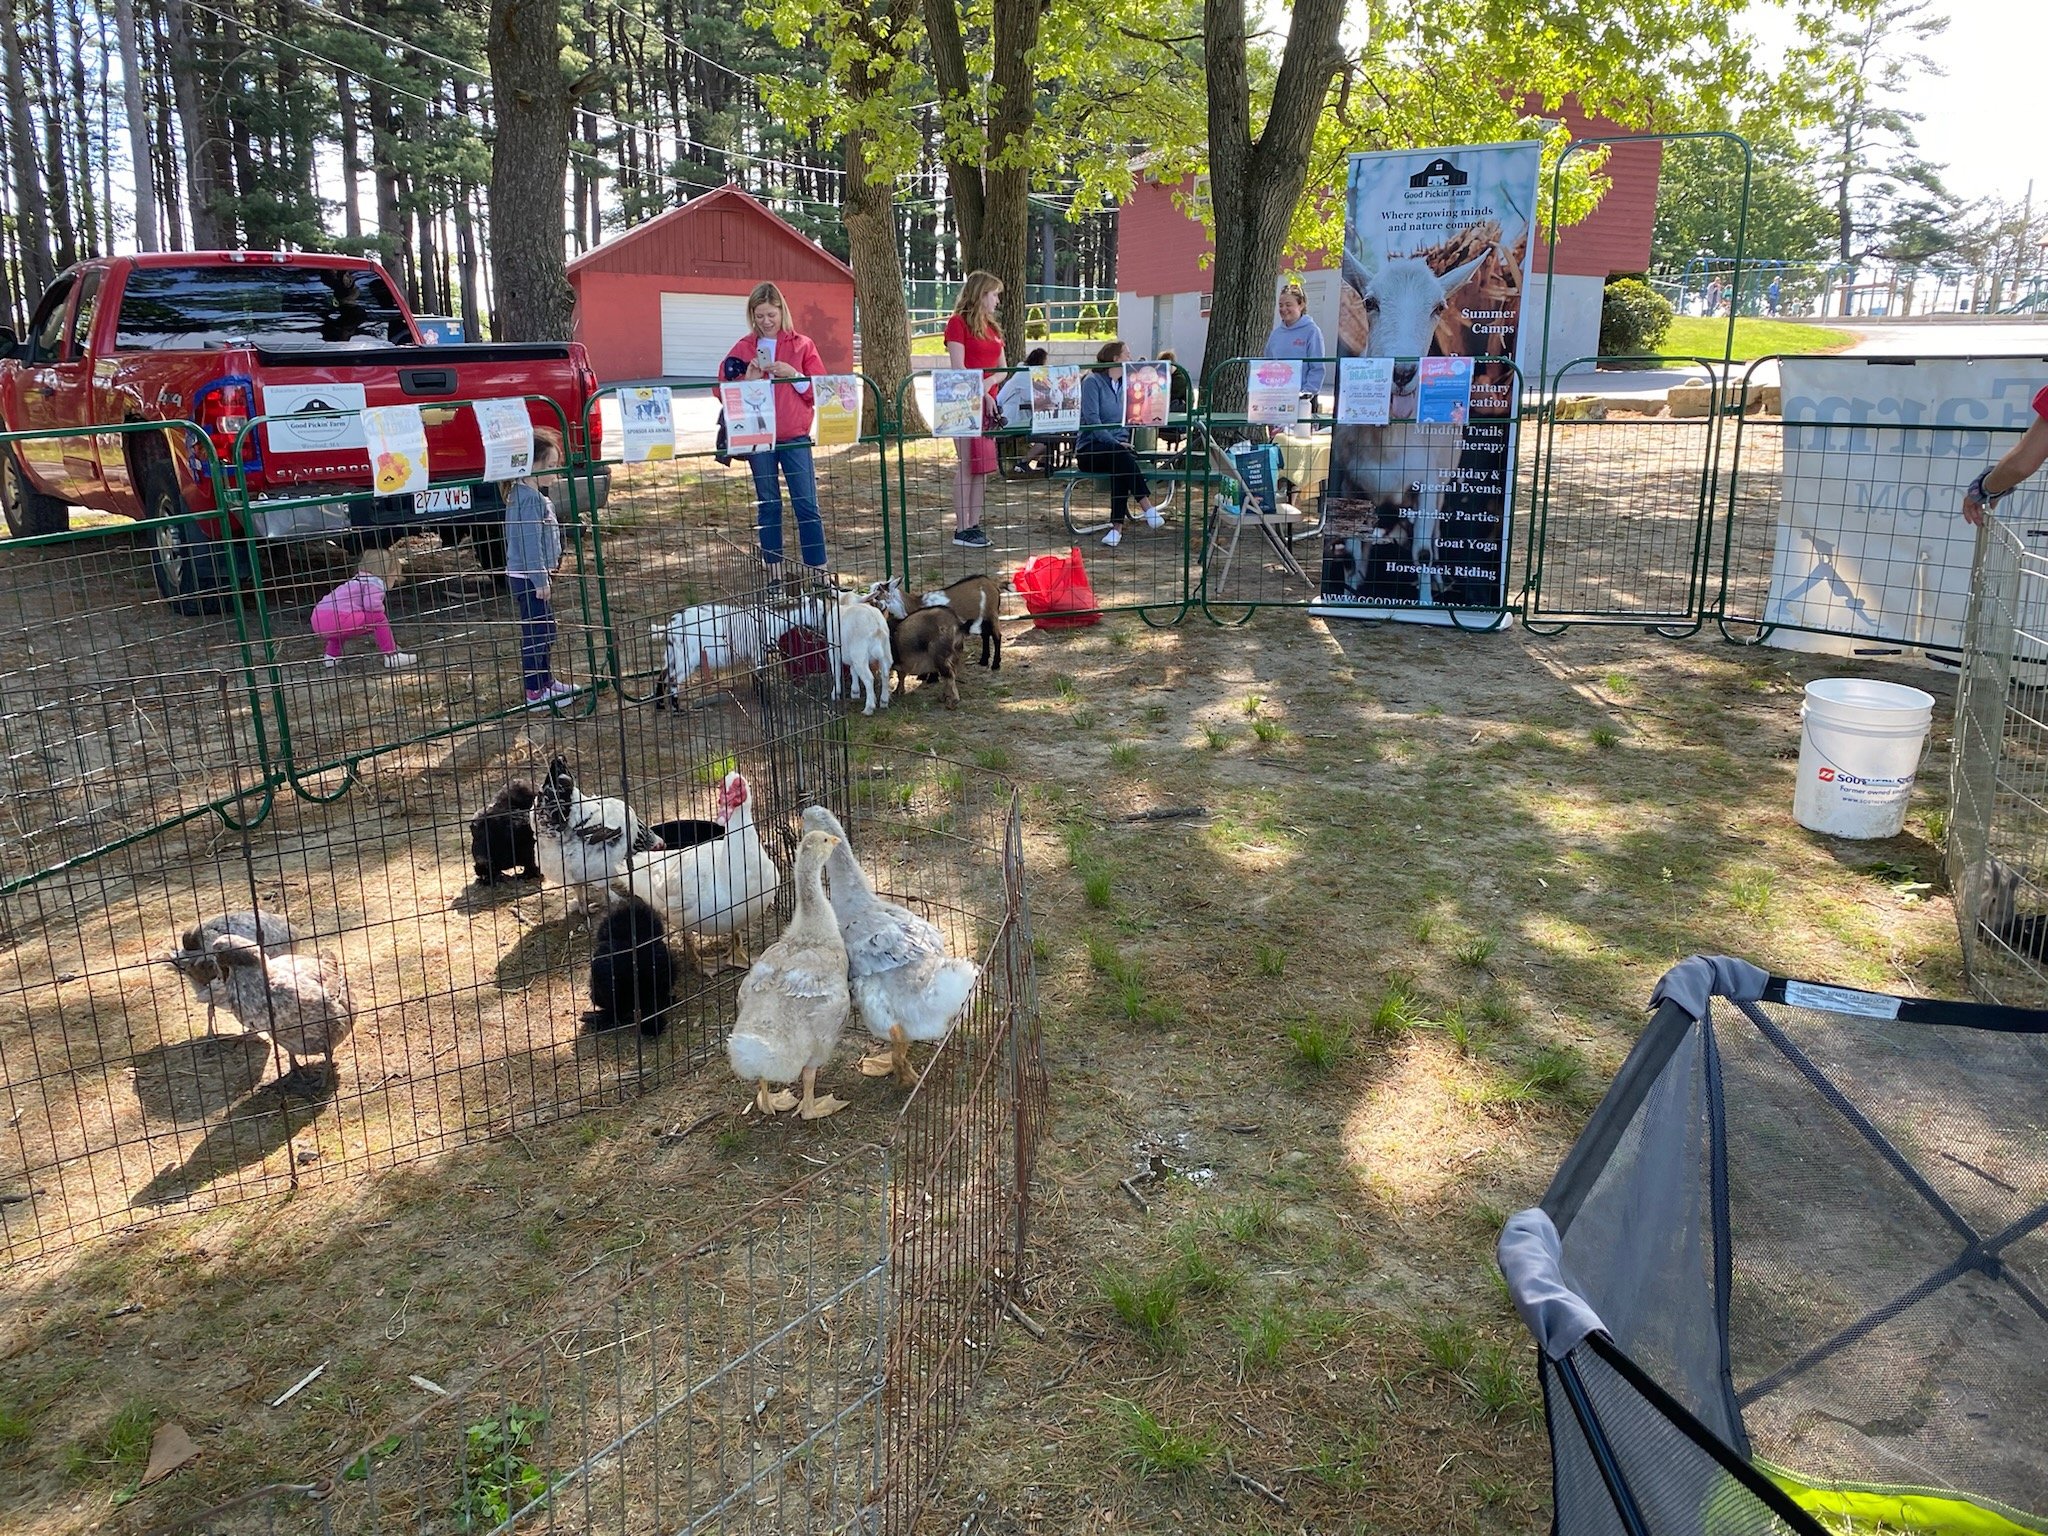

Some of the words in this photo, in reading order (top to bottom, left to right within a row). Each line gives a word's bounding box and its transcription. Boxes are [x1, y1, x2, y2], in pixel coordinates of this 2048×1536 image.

[1403, 190, 1423, 200] Good
[1424, 189, 1450, 199] Pickin'
[1451, 188, 1471, 198] Farm
[1381, 210, 1415, 221] Where
[1416, 208, 1458, 220] growing
[1460, 206, 1494, 217] minds
[1388, 222, 1408, 232] and
[1409, 221, 1443, 231] nature
[1445, 219, 1487, 230] connect
[1461, 308, 1516, 320] Summer
[1471, 323, 1515, 336] Camps
[1470, 383, 1510, 395] entary
[1469, 397, 1509, 409] cation
[290, 421, 308, 430] Good
[329, 420, 346, 428] Farm
[1414, 425, 1463, 435] Mindful
[1466, 426, 1504, 437] Trails
[1453, 439, 1506, 452] Therapy
[276, 463, 370, 478] SIVERADO
[1438, 468, 1489, 481] Holiday
[1489, 469, 1500, 480] &
[1411, 481, 1457, 494] Special
[1459, 483, 1502, 495] Events
[415, 491, 440, 509] 277
[1398, 507, 1453, 522] Birthday
[1455, 510, 1500, 523] Parties
[1434, 538, 1464, 550] Goat
[1466, 539, 1498, 552] Yoga
[1385, 561, 1451, 576] Horseback
[1453, 563, 1497, 580] Riding
[1867, 787, 1891, 796] owned
[1849, 992, 1860, 1001] CAN
